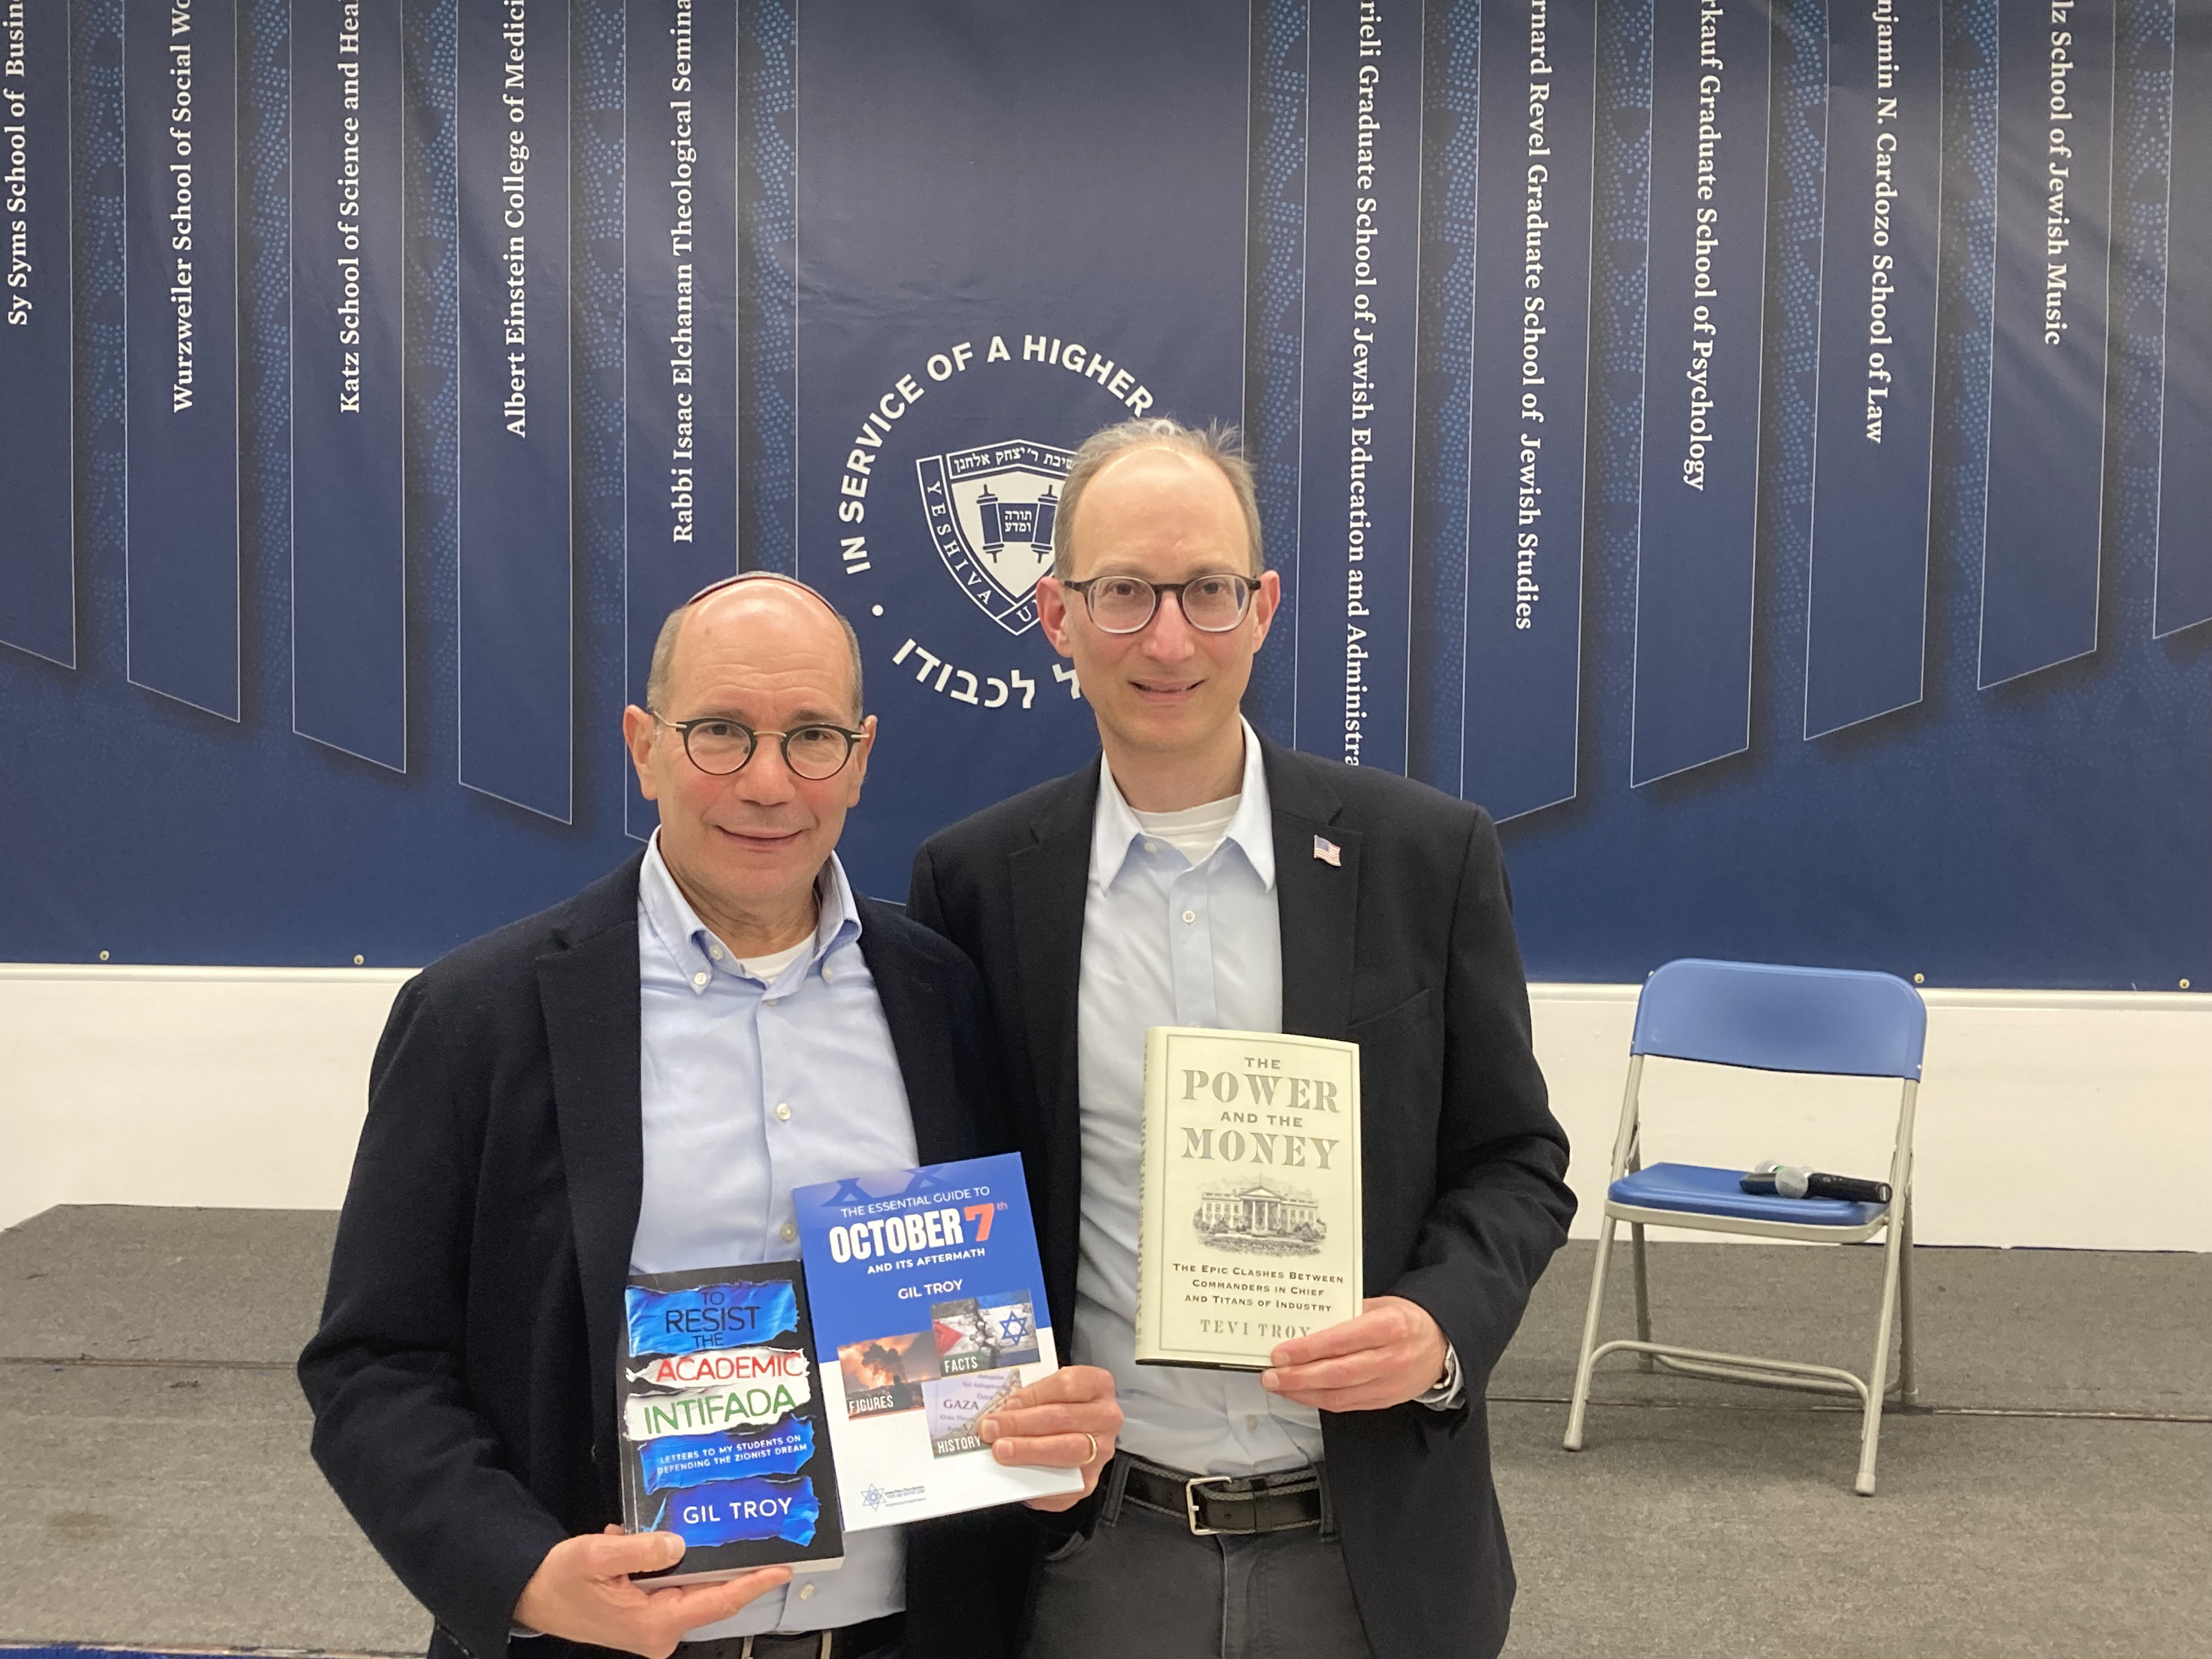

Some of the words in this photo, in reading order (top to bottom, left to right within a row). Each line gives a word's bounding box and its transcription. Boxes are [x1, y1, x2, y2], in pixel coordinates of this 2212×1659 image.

[3, 0, 24, 76] Busin
[338, 0, 358, 54] Hea
[3, 88, 25, 117] of
[170, 44, 191, 121] Social
[337, 63, 358, 109] and
[2051, 32, 2073, 120] School
[503, 94, 524, 122] of
[1357, 66, 1380, 189] Graduate
[1529, 83, 1550, 156] Revel
[1877, 97, 1897, 124] N.
[170, 127, 191, 155] of
[1698, 76, 1722, 200] Graduate
[2050, 128, 2072, 158] of
[4, 126, 26, 212] School
[338, 118, 359, 216] Science
[503, 131, 529, 228] College
[670, 100, 696, 256] Theological
[1874, 133, 1898, 246] Cardozo
[170, 164, 191, 250] School
[1525, 165, 1549, 289] Graduate
[2047, 162, 2069, 256] Jewish
[8, 221, 31, 287] Syms
[337, 221, 359, 250] of
[1356, 198, 1378, 286] School
[1695, 208, 1718, 297] School
[8, 295, 32, 324] Sy
[338, 258, 359, 344] School
[503, 236, 524, 345] Einstein
[1355, 294, 1376, 324] of
[1870, 255, 1894, 345] School
[2045, 263, 2067, 345] Music
[171, 258, 193, 413] Wurzweiler
[670, 263, 692, 385] Elchanan
[1523, 297, 1546, 385] School
[1694, 306, 1716, 335] of
[927, 342, 974, 381] OF
[988, 336, 1011, 363] A
[1023, 335, 1153, 417] HIGHER
[1352, 328, 1374, 420] Jewish
[1869, 353, 1891, 382] of
[340, 353, 359, 413] Katz
[504, 353, 525, 437] Albert
[1522, 393, 1544, 422] of
[673, 393, 692, 460] Isaac
[1684, 340, 1713, 490] Psychology
[1867, 387, 1888, 443] Law
[839, 374, 924, 522] SERVICE
[671, 468, 692, 543] Rabbi
[1349, 428, 1373, 562] Education
[1519, 433, 1542, 525] Jewish
[927, 481, 992, 604] YESHIVA
[1005, 510, 1032, 521] תורה
[1005, 522, 1031, 533] ומדע
[841, 537, 871, 574] IN
[1516, 533, 1539, 629] Studies
[1348, 570, 1369, 617] and
[893, 639, 1035, 709] לכבודו
[1183, 1069, 1341, 1113] POWER
[1244, 1057, 1281, 1070] THE
[1221, 1111, 1258, 1124] AND
[1267, 1115, 1303, 1127] THE
[1181, 1127, 1340, 1169] MONEY
[841, 1206, 865, 1218] THE
[869, 1197, 932, 1215] ESSENTIAL
[933, 1188, 972, 1203] GUIDE
[973, 1187, 990, 1196] TO
[829, 1207, 964, 1263] OCTOBER
[867, 1263, 892, 1274] AND
[896, 1259, 913, 1269] ITS
[917, 1248, 985, 1267] AFTERMATH
[702, 1291, 724, 1306] TO
[898, 1286, 922, 1300] GIL
[924, 1279, 963, 1294] TROY
[665, 1305, 760, 1334] RESIST
[692, 1333, 724, 1348] THE
[1200, 1319, 1249, 1335] TEVI
[1258, 1323, 1311, 1339] TROY
[656, 1352, 803, 1383] ACADEMIC
[944, 1356, 978, 1373] FACTS
[644, 1384, 796, 1435] INTIFADA
[849, 1395, 894, 1414] FIGURES
[944, 1400, 979, 1410] GAZA
[657, 1460, 710, 1474] DEFENDING
[714, 1455, 731, 1465] THE
[735, 1449, 771, 1462] ZIONIST
[775, 1443, 807, 1455] DREAM
[660, 1451, 699, 1464] LETTERS
[703, 1448, 715, 1457] TO
[719, 1445, 732, 1454] MY
[737, 1437, 783, 1452] STUDENTS
[786, 1435, 801, 1443] ON
[937, 1435, 981, 1454] HISTORY
[683, 1506, 721, 1525] GIL
[730, 1497, 792, 1520] TROY
